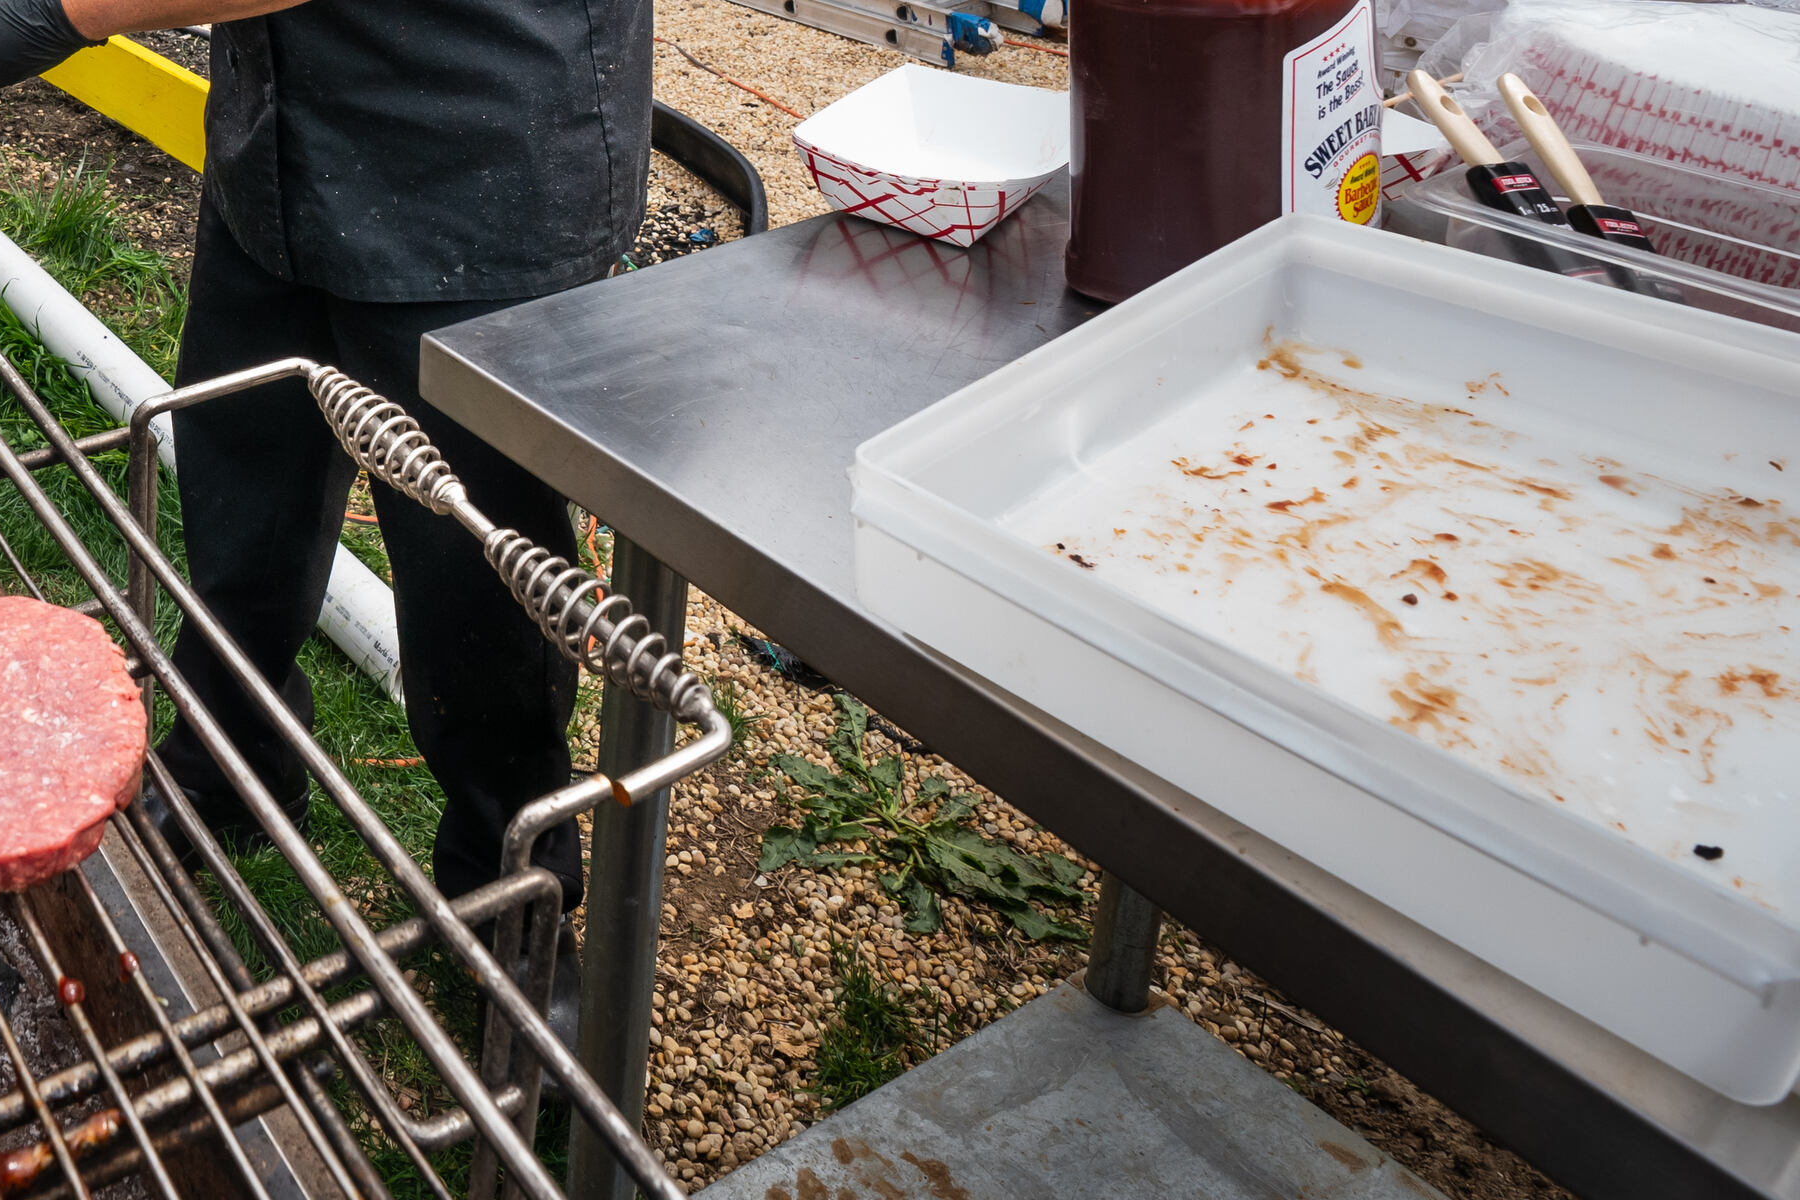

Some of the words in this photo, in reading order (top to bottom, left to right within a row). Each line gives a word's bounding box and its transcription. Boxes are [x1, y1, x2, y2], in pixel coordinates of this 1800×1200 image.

[1316, 81, 1334, 99] The
[1336, 59, 1359, 87] Sauce
[1317, 60, 1336, 79] Award
[1318, 105, 1327, 121] is
[1329, 95, 1343, 112] the
[1304, 118, 1353, 180] SWEET
[1333, 135, 1368, 168] GOURMET
[1353, 192, 1374, 218] Sauce
